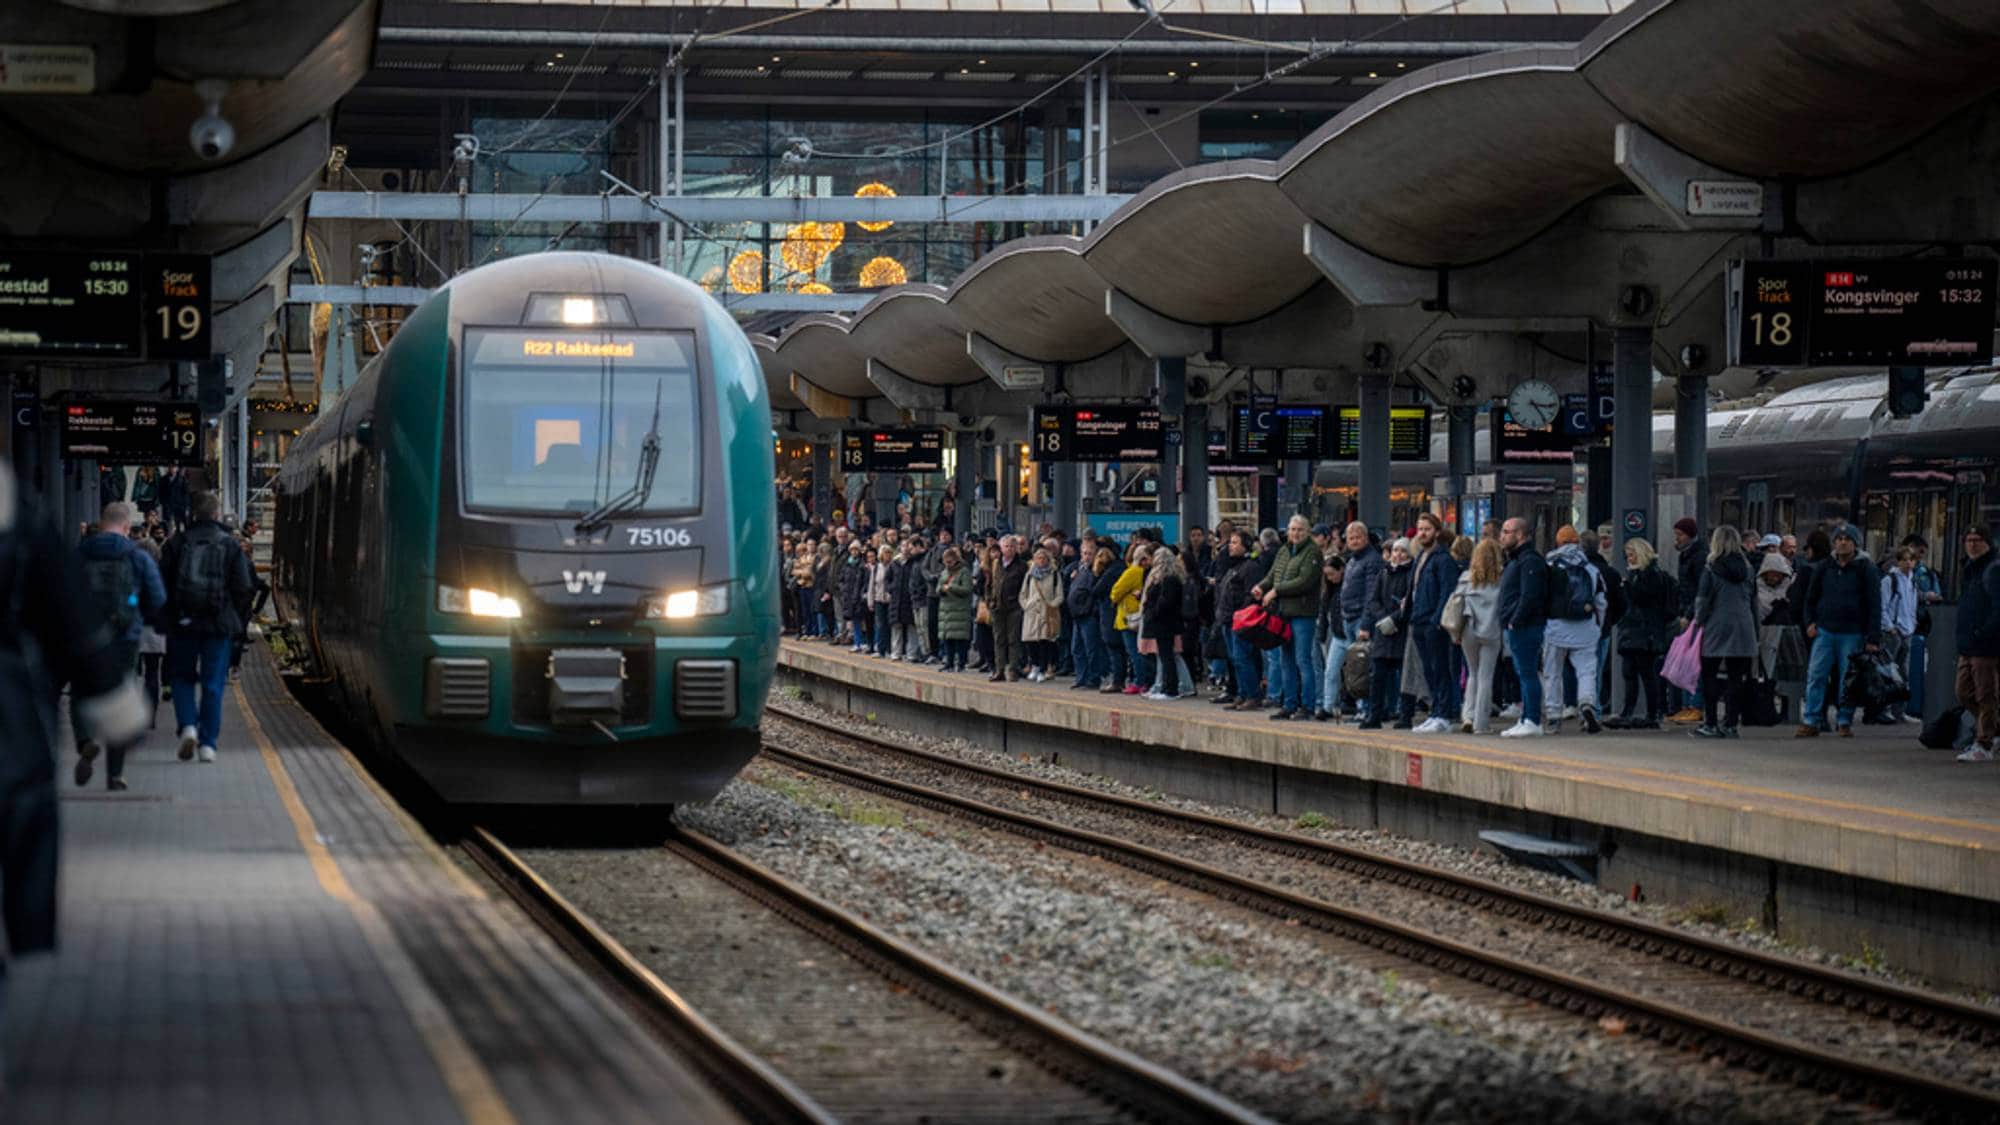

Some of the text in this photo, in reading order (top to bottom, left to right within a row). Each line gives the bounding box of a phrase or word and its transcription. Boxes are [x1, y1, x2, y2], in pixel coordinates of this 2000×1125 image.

[162, 270, 193, 286] Spor
[1757, 277, 1788, 292] Spor
[83, 279, 128, 295] 15:30
[162, 283, 200, 297] Track
[1757, 290, 1792, 303] Track
[1824, 288, 1920, 306] Kongsvinger
[1938, 288, 1983, 304] 15:32
[155, 304, 202, 341] 19
[1750, 311, 1793, 346] 18
[524, 340, 634, 357] R22 Rakkestad
[1257, 411, 1271, 429] C
[1572, 411, 1586, 430] C
[170, 430, 197, 449] 19
[1037, 432, 1061, 453] 18
[844, 449, 863, 466] 18
[626, 527, 691, 546] 75106
